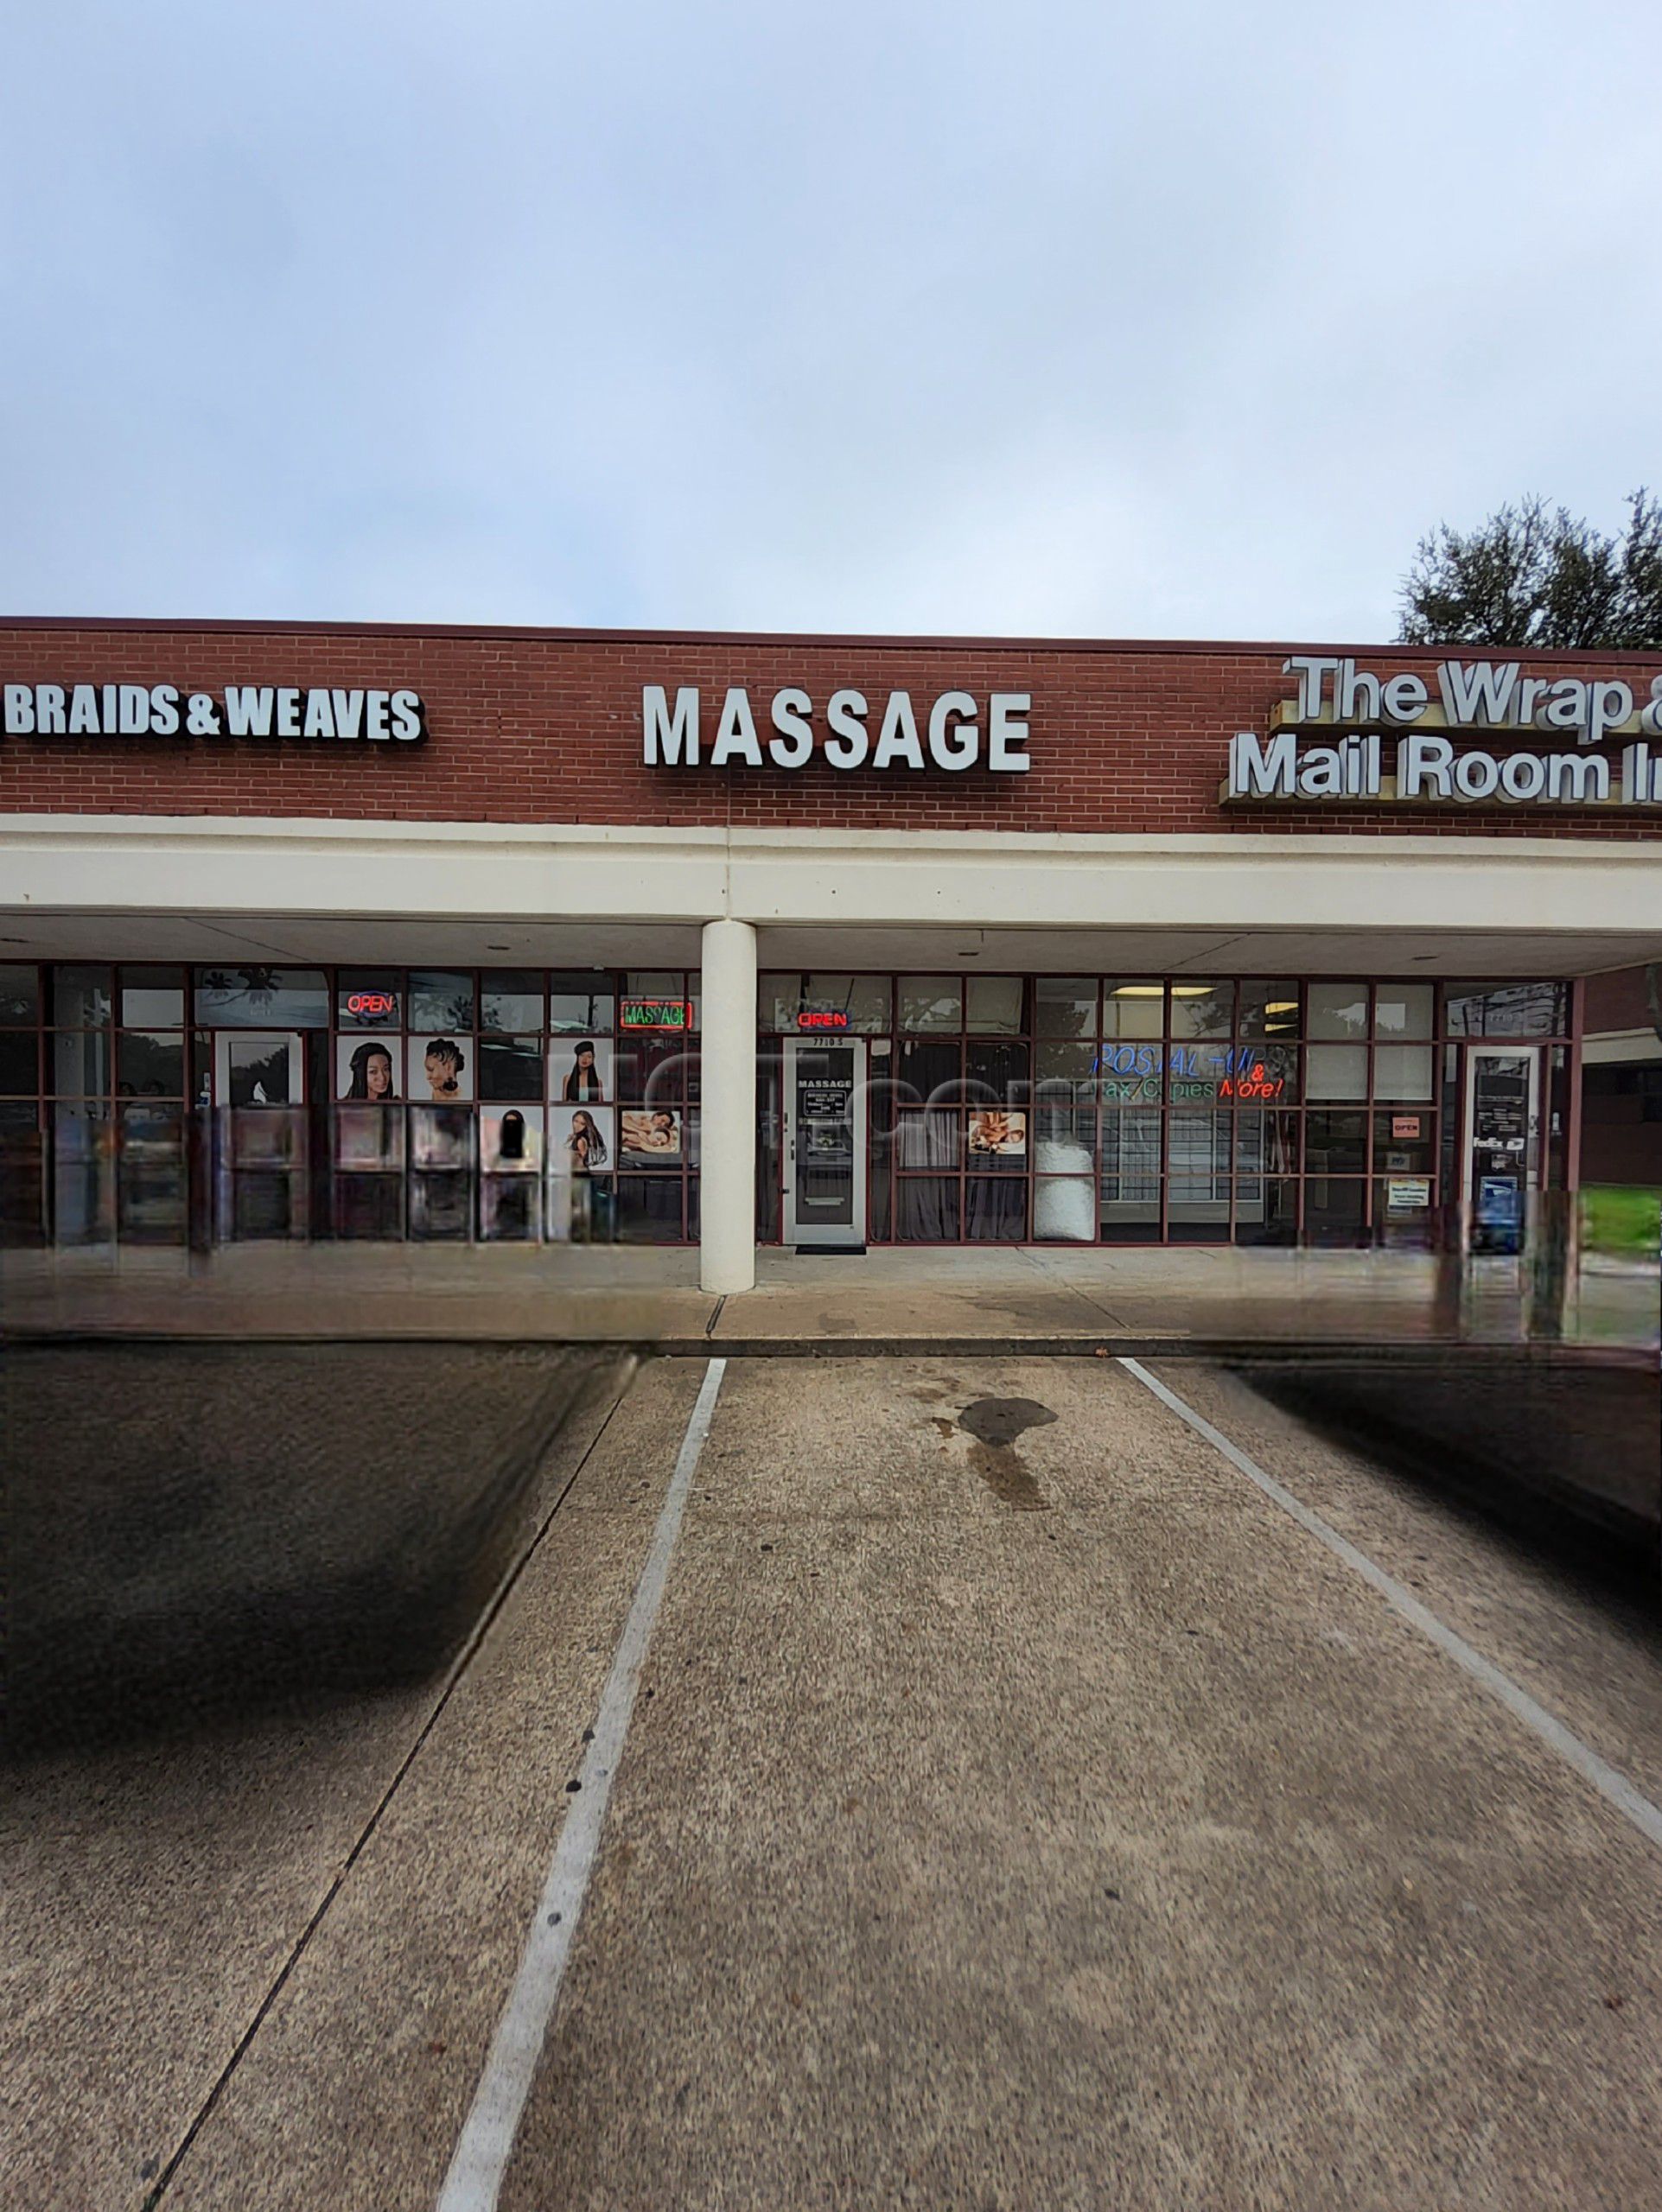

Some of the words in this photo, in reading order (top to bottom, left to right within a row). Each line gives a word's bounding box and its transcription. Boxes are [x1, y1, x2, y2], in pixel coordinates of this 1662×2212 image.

[3, 683, 180, 734] BRAIDS
[186, 693, 221, 736] &
[223, 686, 423, 741] WEAVES
[1288, 656, 1428, 723] The
[1443, 660, 1633, 741] Wrap
[643, 684, 1031, 772] MASSAGE
[1234, 733, 1380, 796] Mail
[1404, 734, 1609, 801] Room
[347, 995, 393, 1014] OPEN
[798, 1012, 848, 1027] OPEN
[1251, 1063, 1265, 1082] &
